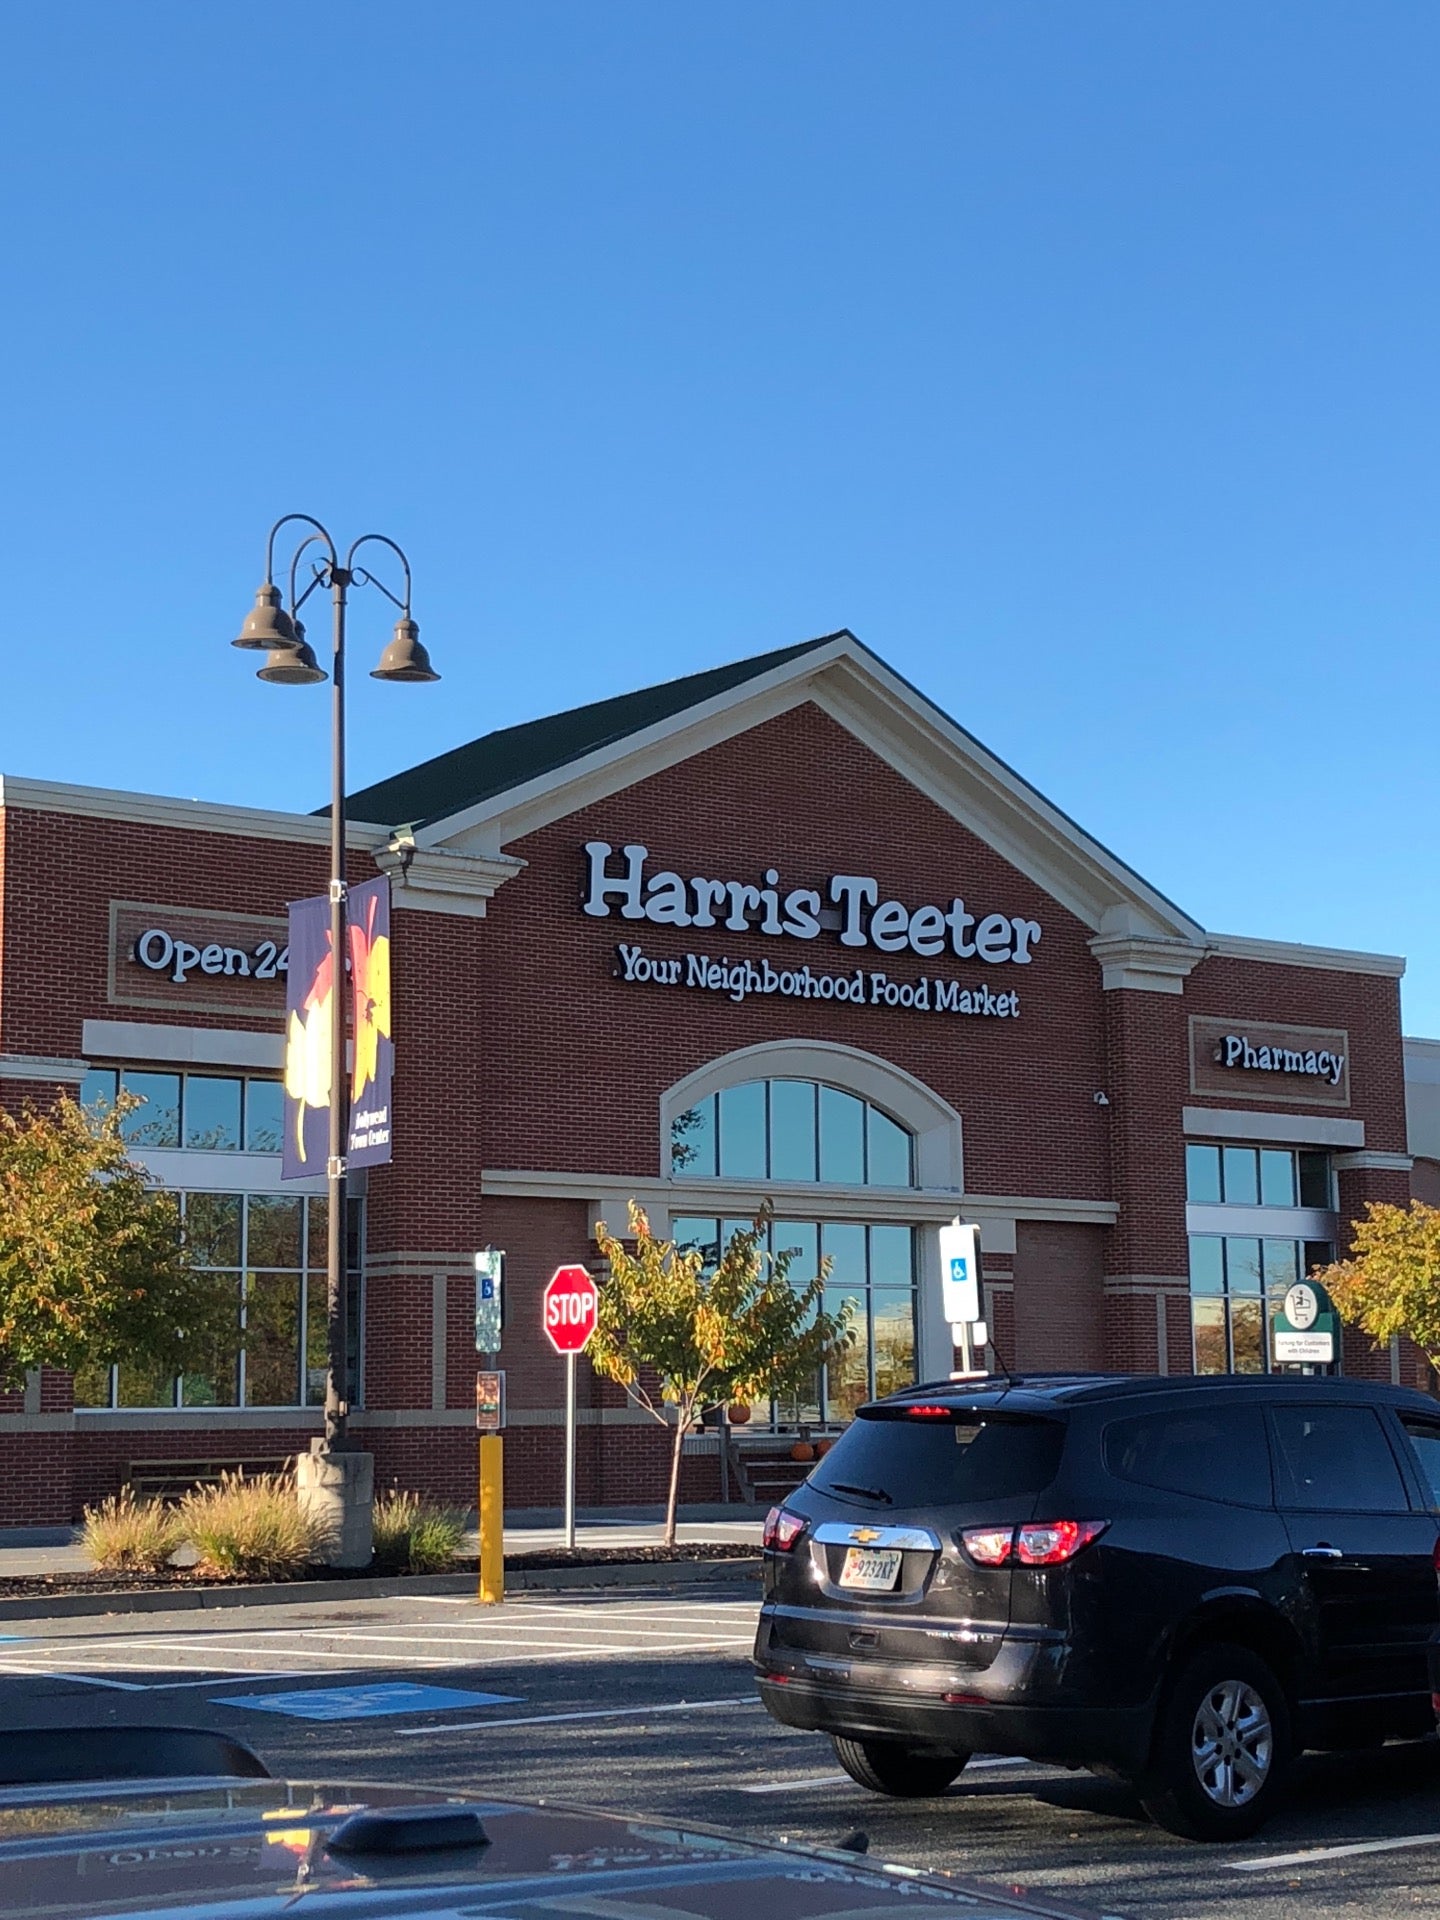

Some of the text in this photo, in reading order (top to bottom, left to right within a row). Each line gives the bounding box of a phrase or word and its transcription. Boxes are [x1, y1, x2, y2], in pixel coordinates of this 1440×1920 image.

[584, 841, 1042, 964] Harris Teeter
[139, 929, 250, 983] Open
[618, 943, 1020, 1018] Your Neighborhood Food Market
[1225, 1035, 1345, 1086] Pharmacy
[548, 1291, 594, 1327] STOP
